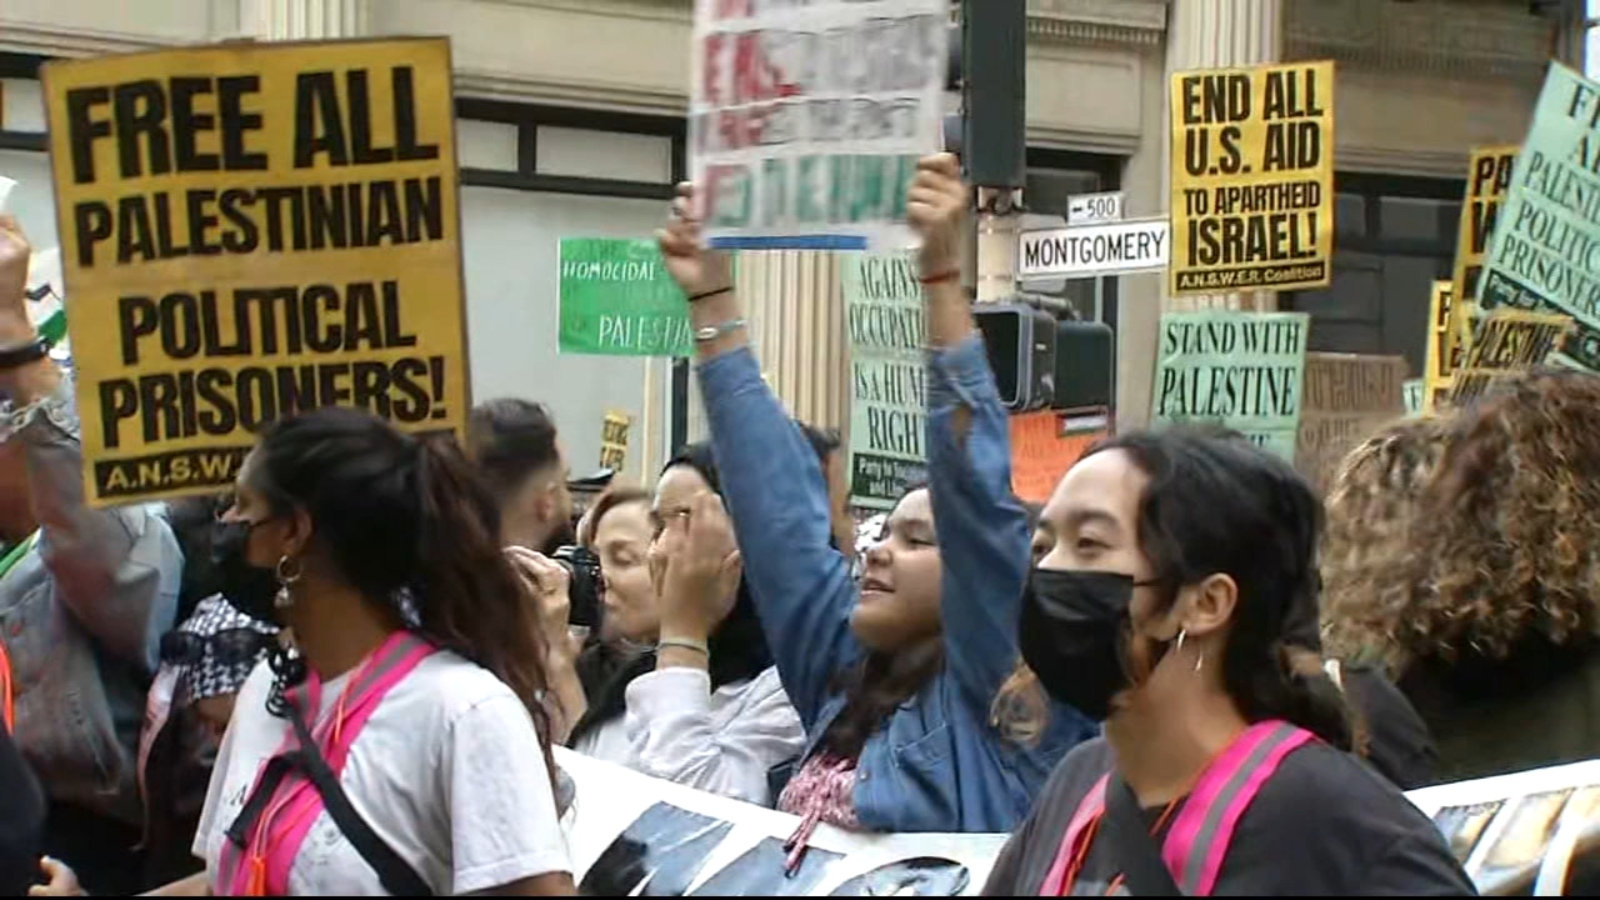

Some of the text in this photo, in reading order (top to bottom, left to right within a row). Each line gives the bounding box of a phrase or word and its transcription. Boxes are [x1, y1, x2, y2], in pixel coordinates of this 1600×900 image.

[1182, 69, 1323, 125] END ALL
[67, 66, 439, 184] FREE ALL
[1185, 121, 1320, 177] U.S. AID
[75, 177, 443, 268] PALESTINIAN
[1086, 197, 1116, 218] 500
[1183, 180, 1321, 217] TO APARTHEID
[1025, 229, 1166, 267] MONTGOMERY
[1188, 213, 1317, 266] ISRAEL!
[118, 281, 416, 366] POLITICAL
[1164, 321, 1300, 355] STAND WITH
[99, 357, 447, 449] PRISONERS!
[1157, 366, 1297, 416] PALESTINE
